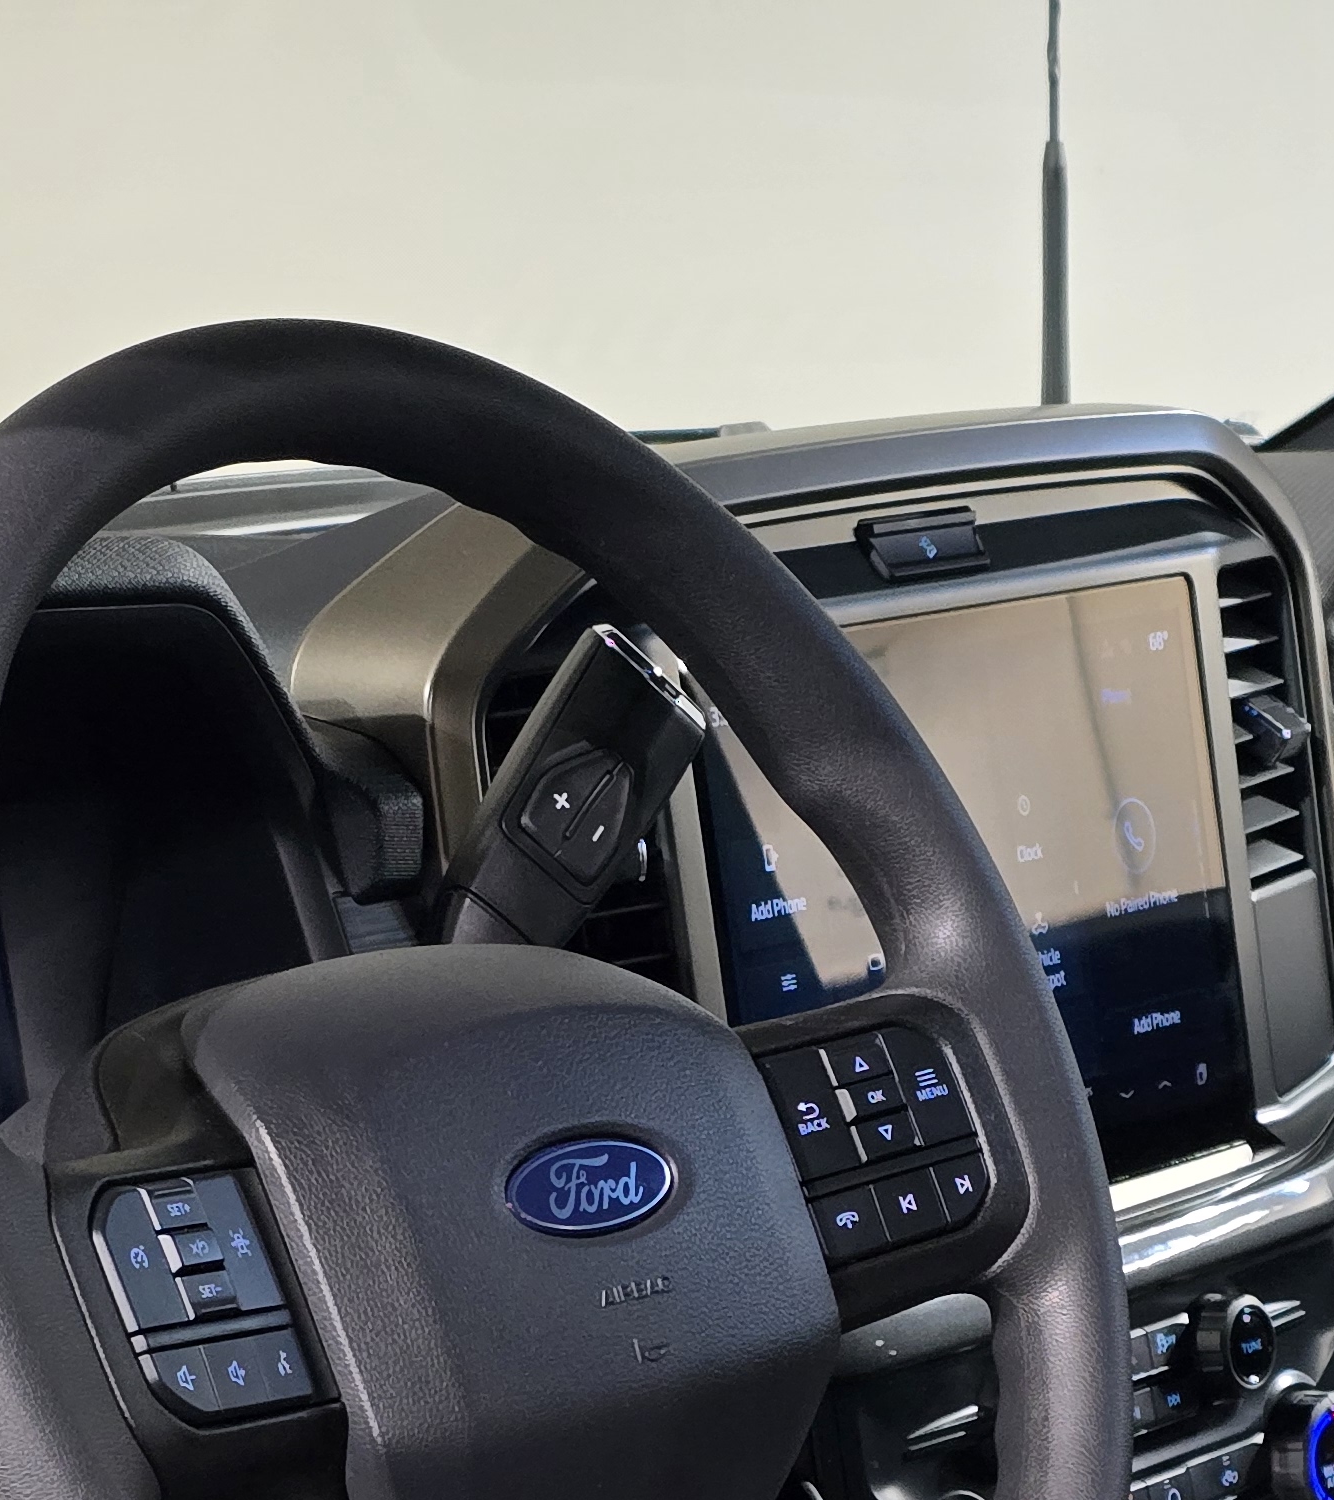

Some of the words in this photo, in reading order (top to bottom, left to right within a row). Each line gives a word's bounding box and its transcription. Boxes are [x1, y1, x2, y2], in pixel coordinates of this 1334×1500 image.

[1017, 842, 1043, 863] Clock
[751, 901, 771, 922] Add
[772, 896, 807, 918] Phone
[1106, 901, 1120, 918] No
[1120, 892, 1150, 915] Paired
[1149, 888, 1178, 908] Phone
[1038, 947, 1061, 967] hicle
[1047, 970, 1066, 990] pot
[1133, 1015, 1153, 1035] Add
[1153, 1009, 1181, 1030] Phone
[867, 1089, 886, 1103] OK
[916, 1084, 949, 1101] MENU
[797, 1118, 830, 1136] BACK
[548, 1153, 644, 1220] Ford
[167, 1202, 191, 1217] SET+
[1241, 1338, 1263, 1354] TUNE
